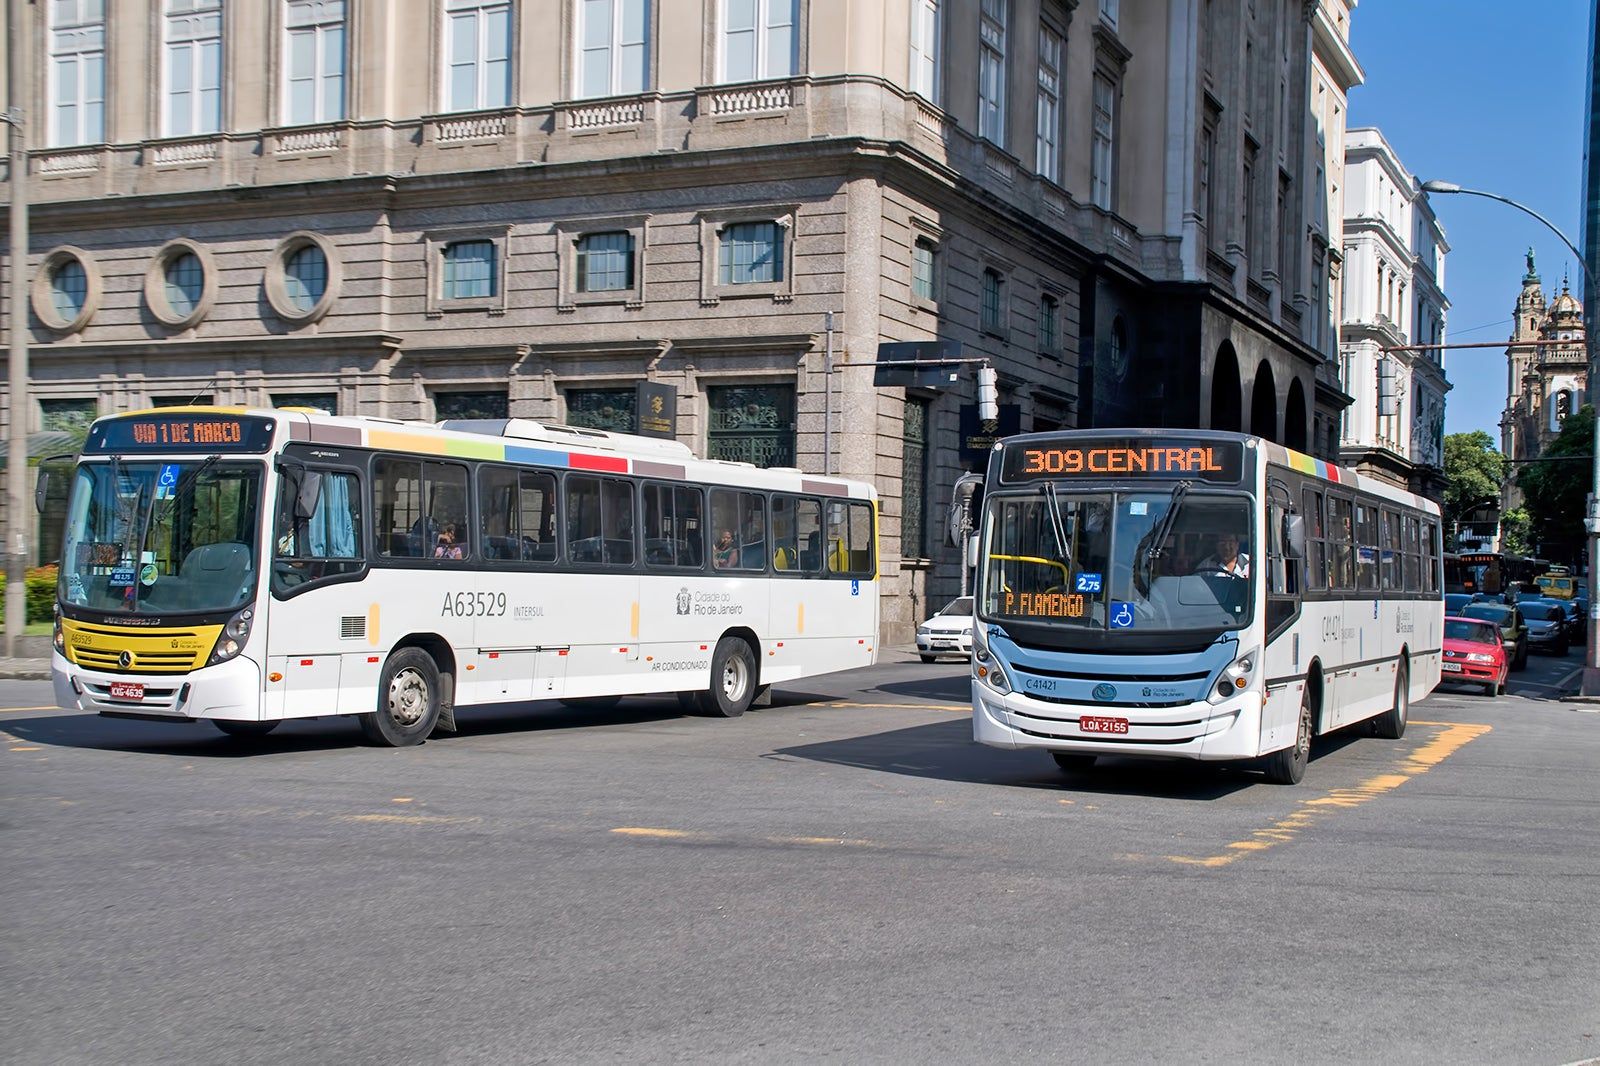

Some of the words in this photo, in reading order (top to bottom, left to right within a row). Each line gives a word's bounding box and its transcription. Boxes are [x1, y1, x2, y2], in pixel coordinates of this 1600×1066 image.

[133, 423, 157, 443] VIA
[160, 423, 168, 443] 1
[171, 423, 190, 443] DE
[193, 422, 241, 443] MARCO
[1023, 450, 1083, 473] 309
[1087, 448, 1222, 472] CENTRAL
[1077, 577, 1100, 591] 2,75
[441, 592, 507, 617] A63529
[513, 606, 544, 617] INTERSUL
[1020, 593, 1084, 617] FLAMENGO
[71, 633, 92, 645] A63529
[662, 660, 708, 671] CONDICIONADO
